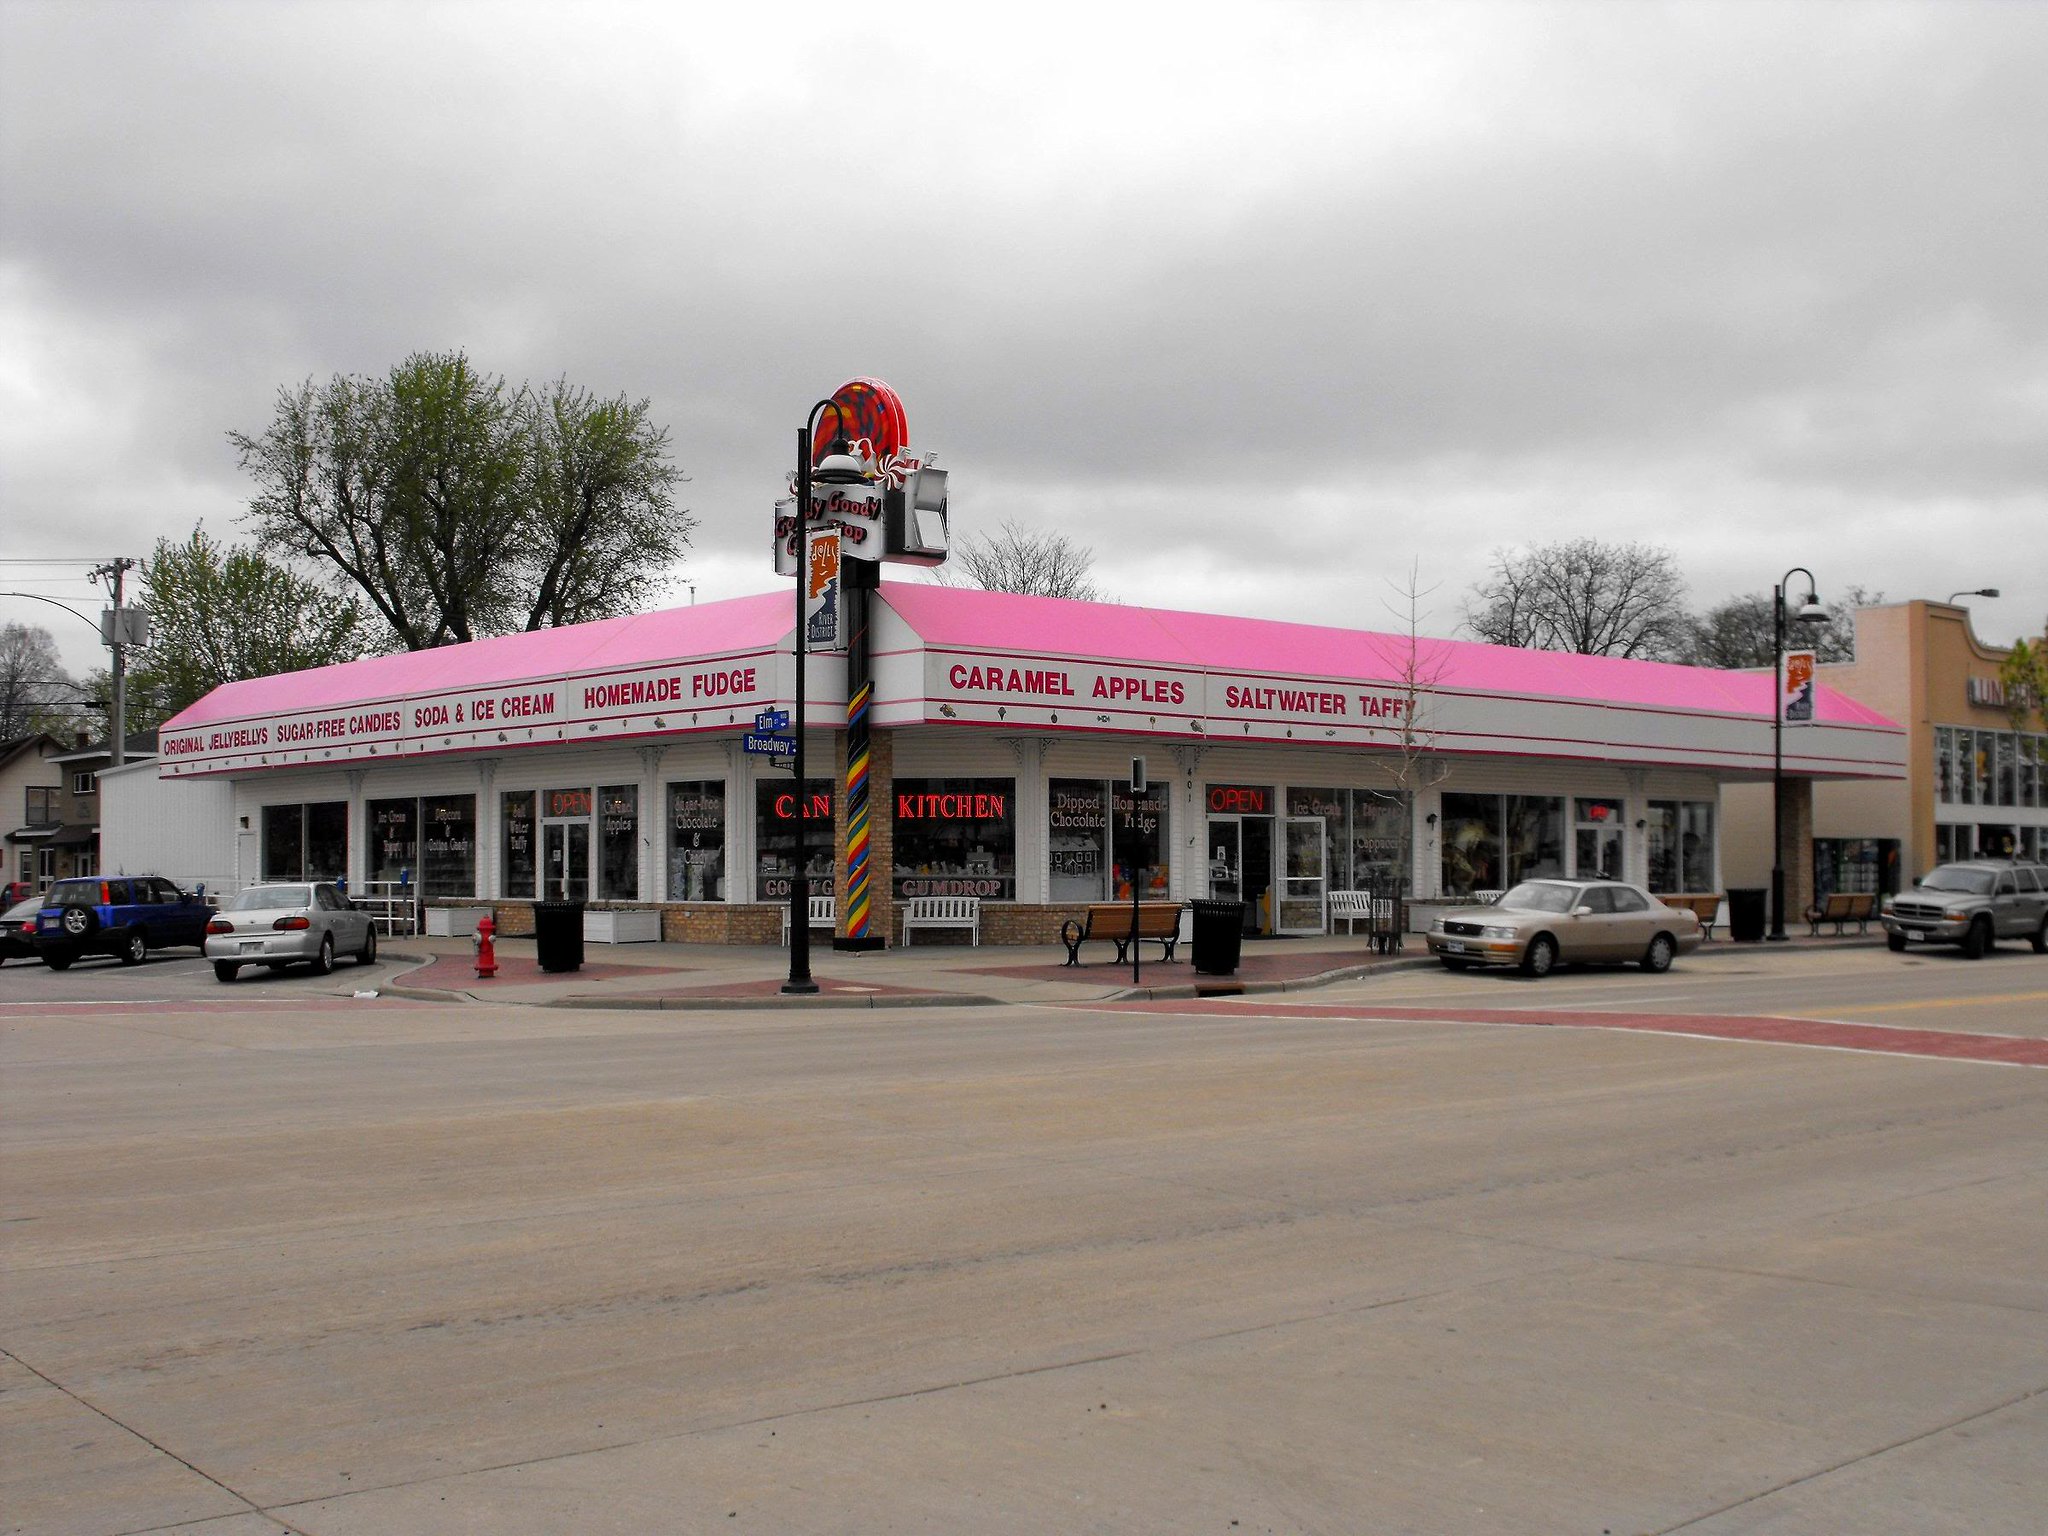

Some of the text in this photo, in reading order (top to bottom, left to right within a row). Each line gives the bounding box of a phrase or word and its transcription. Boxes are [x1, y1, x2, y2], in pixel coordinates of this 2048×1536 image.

[828, 491, 881, 520] Goody
[819, 612, 833, 625] RIVER
[584, 668, 756, 709] HOMEMADE FUDGE
[949, 664, 1185, 705] CARAMEL APPLES
[1226, 685, 1346, 716] SALTWATER
[414, 693, 554, 728] SODA & ICE CREAM
[277, 711, 401, 743] SUGAR-FREE CANDIES
[759, 716, 773, 729] Elm
[163, 728, 268, 756] ORIGINAL JELLYBELLYS
[748, 736, 790, 755] Broadway
[552, 791, 591, 816] OPEN
[898, 794, 1005, 818] KITCHEN
[1057, 794, 1099, 813] Dipped
[1210, 788, 1264, 812] OPEN
[1293, 800, 1308, 814] Ice
[606, 817, 632, 835] Apples
[676, 814, 718, 829] Chocolate
[1050, 811, 1106, 828] Chocolate
[510, 836, 528, 853] Taffy
[692, 832, 701, 847] &
[902, 880, 1001, 896] GUMDROP
